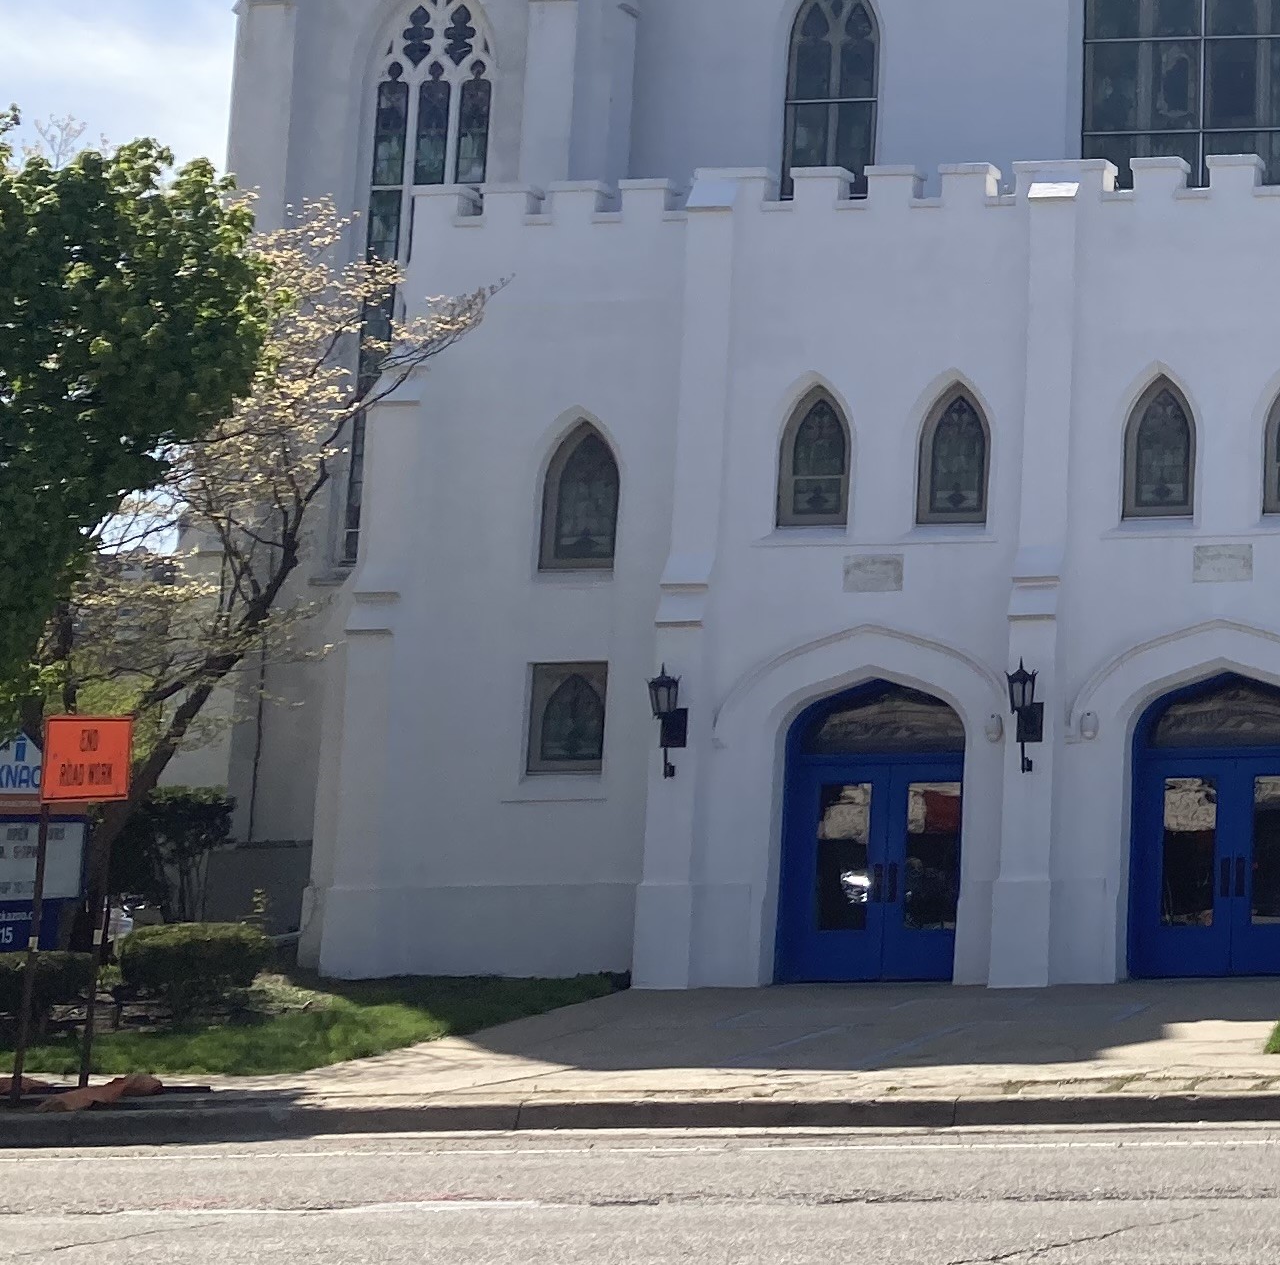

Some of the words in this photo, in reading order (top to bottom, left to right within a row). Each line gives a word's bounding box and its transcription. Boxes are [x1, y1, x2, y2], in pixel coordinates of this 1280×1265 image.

[80, 729, 98, 752] END
[59, 763, 85, 787] ROAD
[88, 763, 113, 786] WORK
